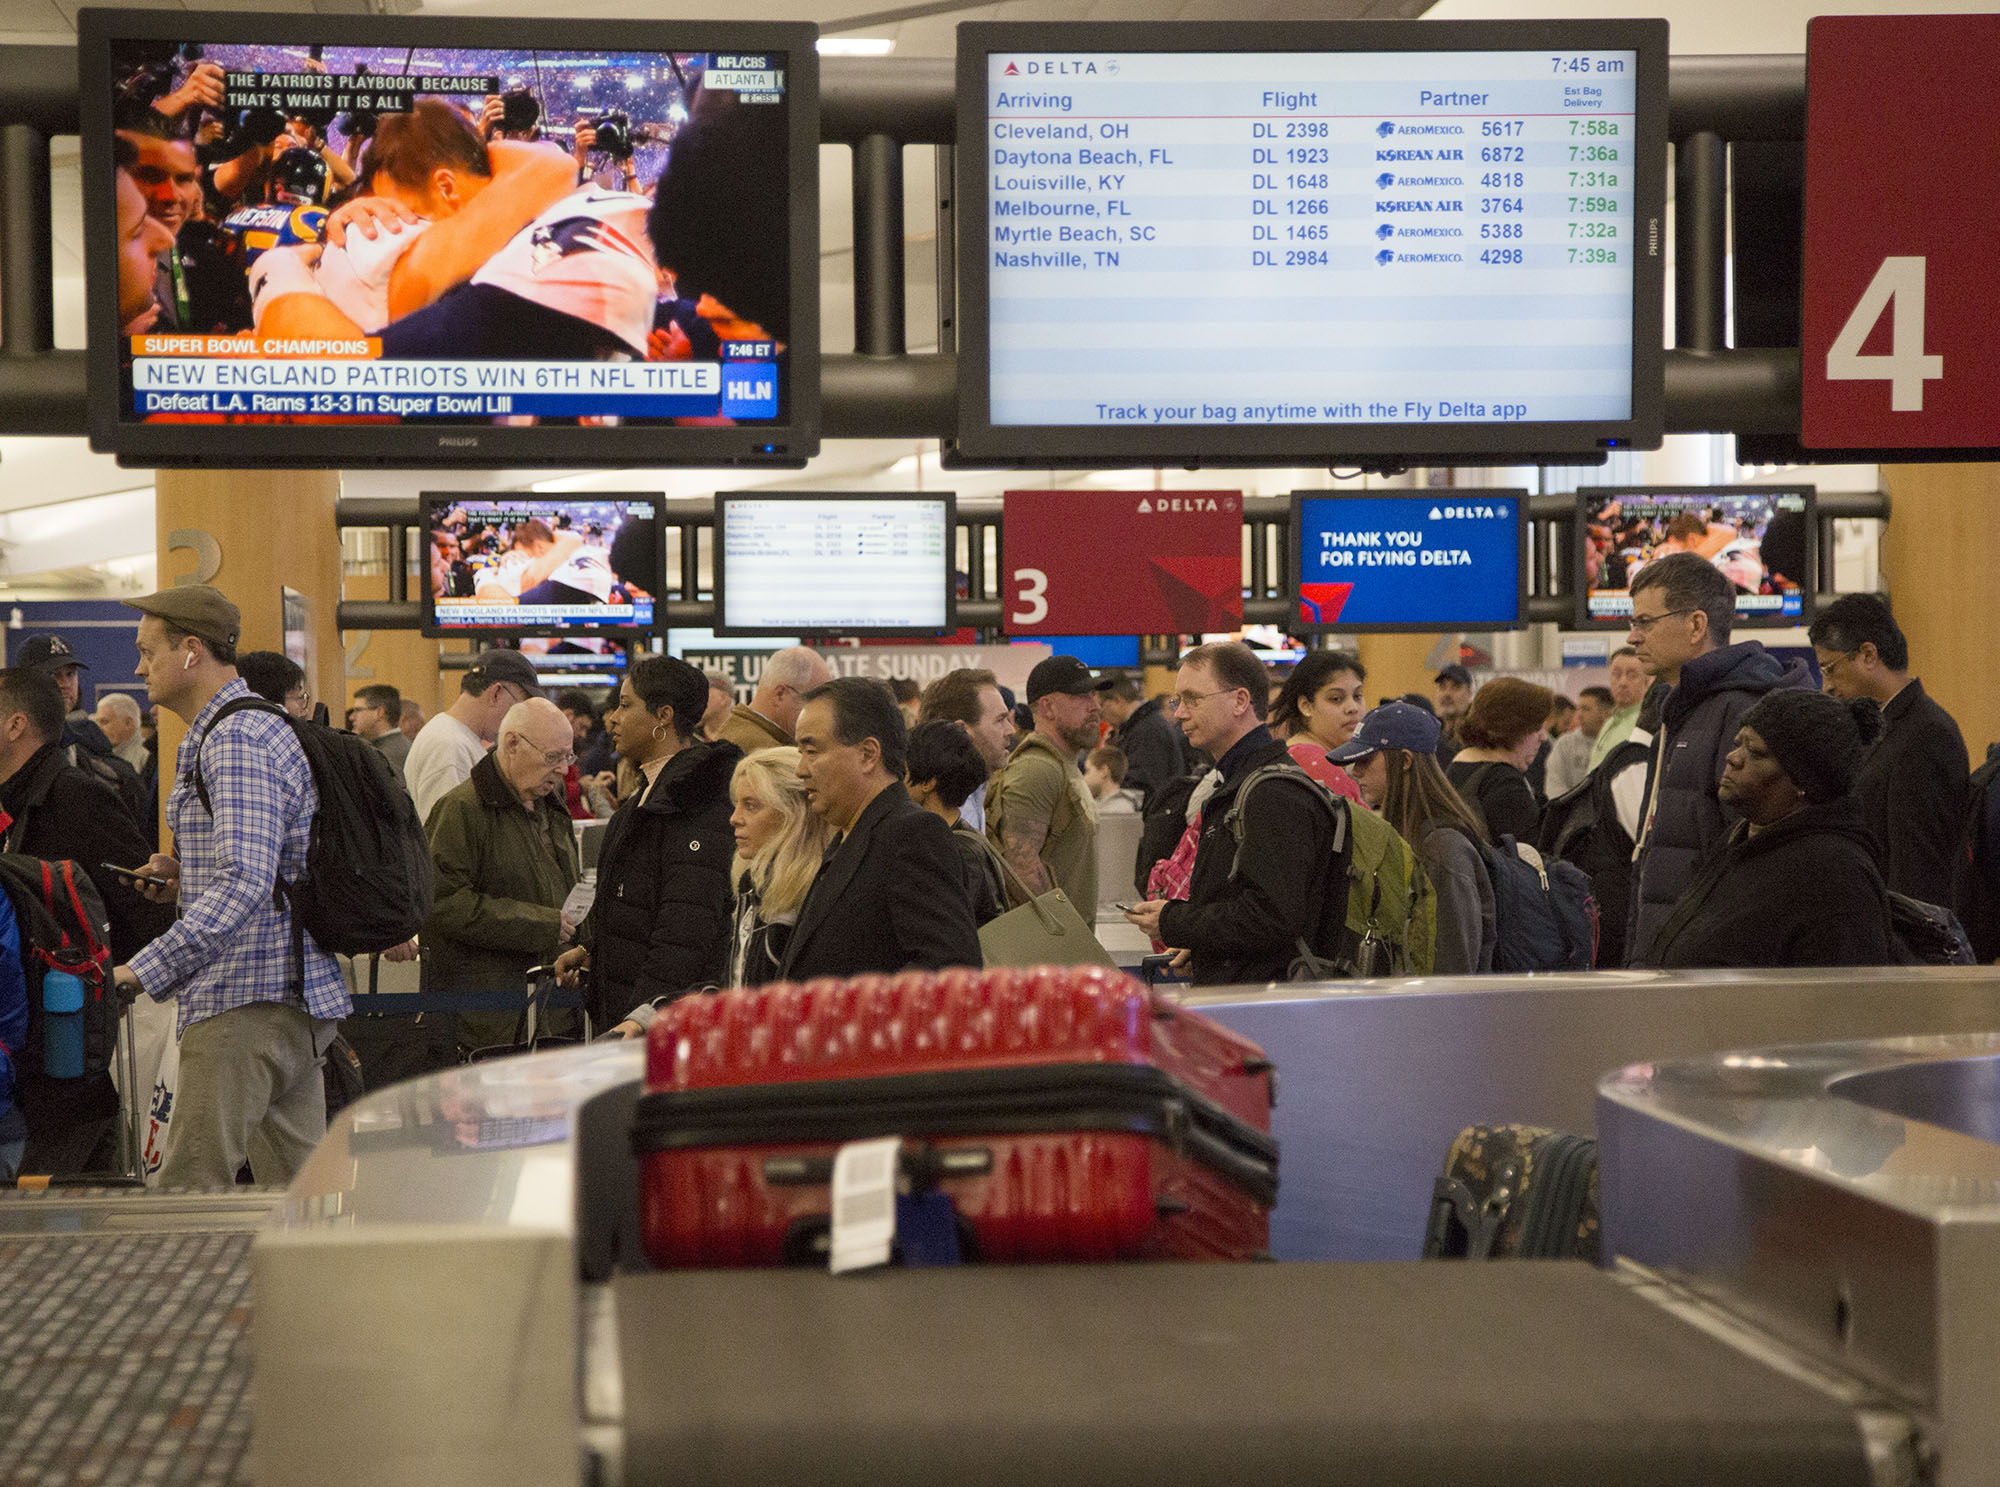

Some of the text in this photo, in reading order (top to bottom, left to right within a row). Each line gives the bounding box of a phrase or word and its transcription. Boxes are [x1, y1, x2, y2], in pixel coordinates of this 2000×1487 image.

[717, 56, 766, 69] NFL/CBS
[1028, 62, 1097, 75] DELTA
[1552, 57, 1625, 73] 7:45 am
[227, 73, 489, 91] THE PATRIOTS PLAYBOOK BECAUSE
[715, 73, 766, 85] ATLANTA
[1565, 86, 1602, 97] Est Bag
[228, 93, 403, 109] THAT'S WHAT IT IS ALL
[996, 91, 1488, 111] Arriving Flight Partner
[1564, 98, 1603, 109] Delivery
[994, 124, 1092, 141] Cleveland,
[1100, 124, 1128, 138] OH
[1253, 123, 1278, 138] DL
[1286, 123, 1328, 137] 2398
[1482, 121, 1524, 136] 5617
[1569, 121, 1618, 135] 7:58a
[995, 146, 1617, 168] Daytona Beach, FL DL 1923 KOREAN AIR 6872 7:36a
[995, 175, 1091, 192] Louisville,
[1100, 175, 1124, 189] KY
[1253, 175, 1277, 189] DL
[1288, 174, 1328, 189] 1648
[1481, 173, 1523, 187] 4818
[1569, 172, 1617, 186] 7:31a
[993, 197, 1617, 217] Melbourne, FL DL 1266 KOREAN AIR 3764 7:59a
[995, 226, 1052, 245] Myrtle
[1060, 226, 1121, 242] Beach,
[1131, 226, 1155, 240] SC
[1253, 226, 1277, 240] DL
[1288, 225, 1328, 240] 1465
[1481, 224, 1522, 238] 5388
[1568, 223, 1616, 237] 7:32a
[1649, 218, 1658, 256] PHILIPS
[995, 252, 1086, 268] Nashville,
[1095, 252, 1118, 266] TN
[1253, 251, 1277, 265] DL
[1286, 251, 1328, 265] 2984
[1480, 249, 1522, 264] 4298
[1568, 248, 1616, 263] 7:39a
[1827, 256, 1943, 411] 4
[145, 339, 369, 354] SUPER BOWL CHAMPIONS
[728, 344, 770, 356] 7:46 ET
[147, 364, 707, 388] NEW ENGLAND PATRIOTS WIN 6TH NFL TITLE
[728, 381, 771, 400] HLN
[146, 393, 208, 411] Defeat
[213, 394, 247, 411] L.A.
[253, 395, 306, 411] Rams
[311, 396, 351, 412] 13-3
[357, 396, 373, 412] in
[378, 395, 433, 415] Super
[437, 396, 482, 412] Bowl
[1096, 402, 1527, 423] Track your bag anytime with the Fly Delta app
[439, 437, 478, 447] PHILIPS
[1157, 498, 1218, 512] DELTA
[1444, 506, 1494, 519] DELTA
[1320, 531, 1422, 547] THANK YOU
[1320, 550, 1472, 566] FOR FLYING DELTA
[1013, 568, 1048, 625] 3
[686, 653, 982, 682] THE UATE SUNDAY
